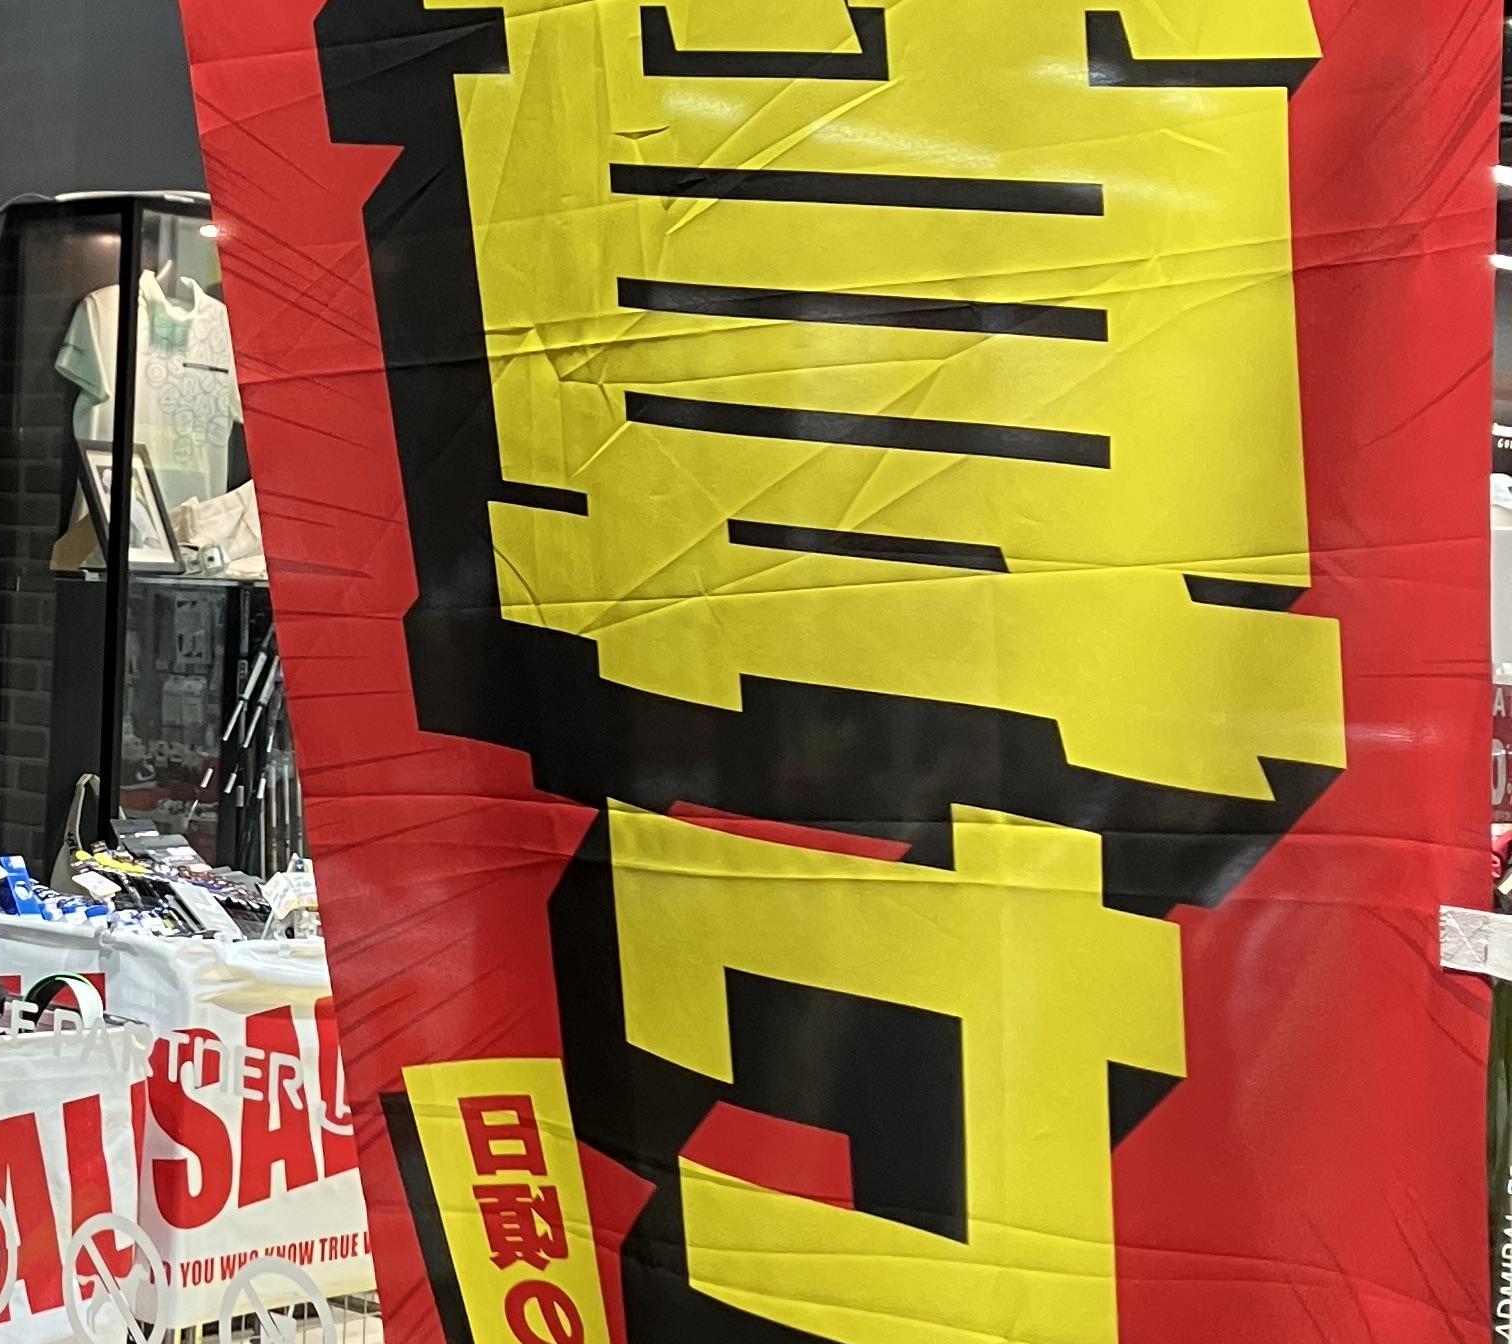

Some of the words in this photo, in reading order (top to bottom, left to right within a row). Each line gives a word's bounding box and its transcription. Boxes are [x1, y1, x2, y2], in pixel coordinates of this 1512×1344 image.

[53, 1007, 303, 1111] PARTNER
[180, 1257, 215, 1288] YOU
[319, 1232, 359, 1263] TRUE
